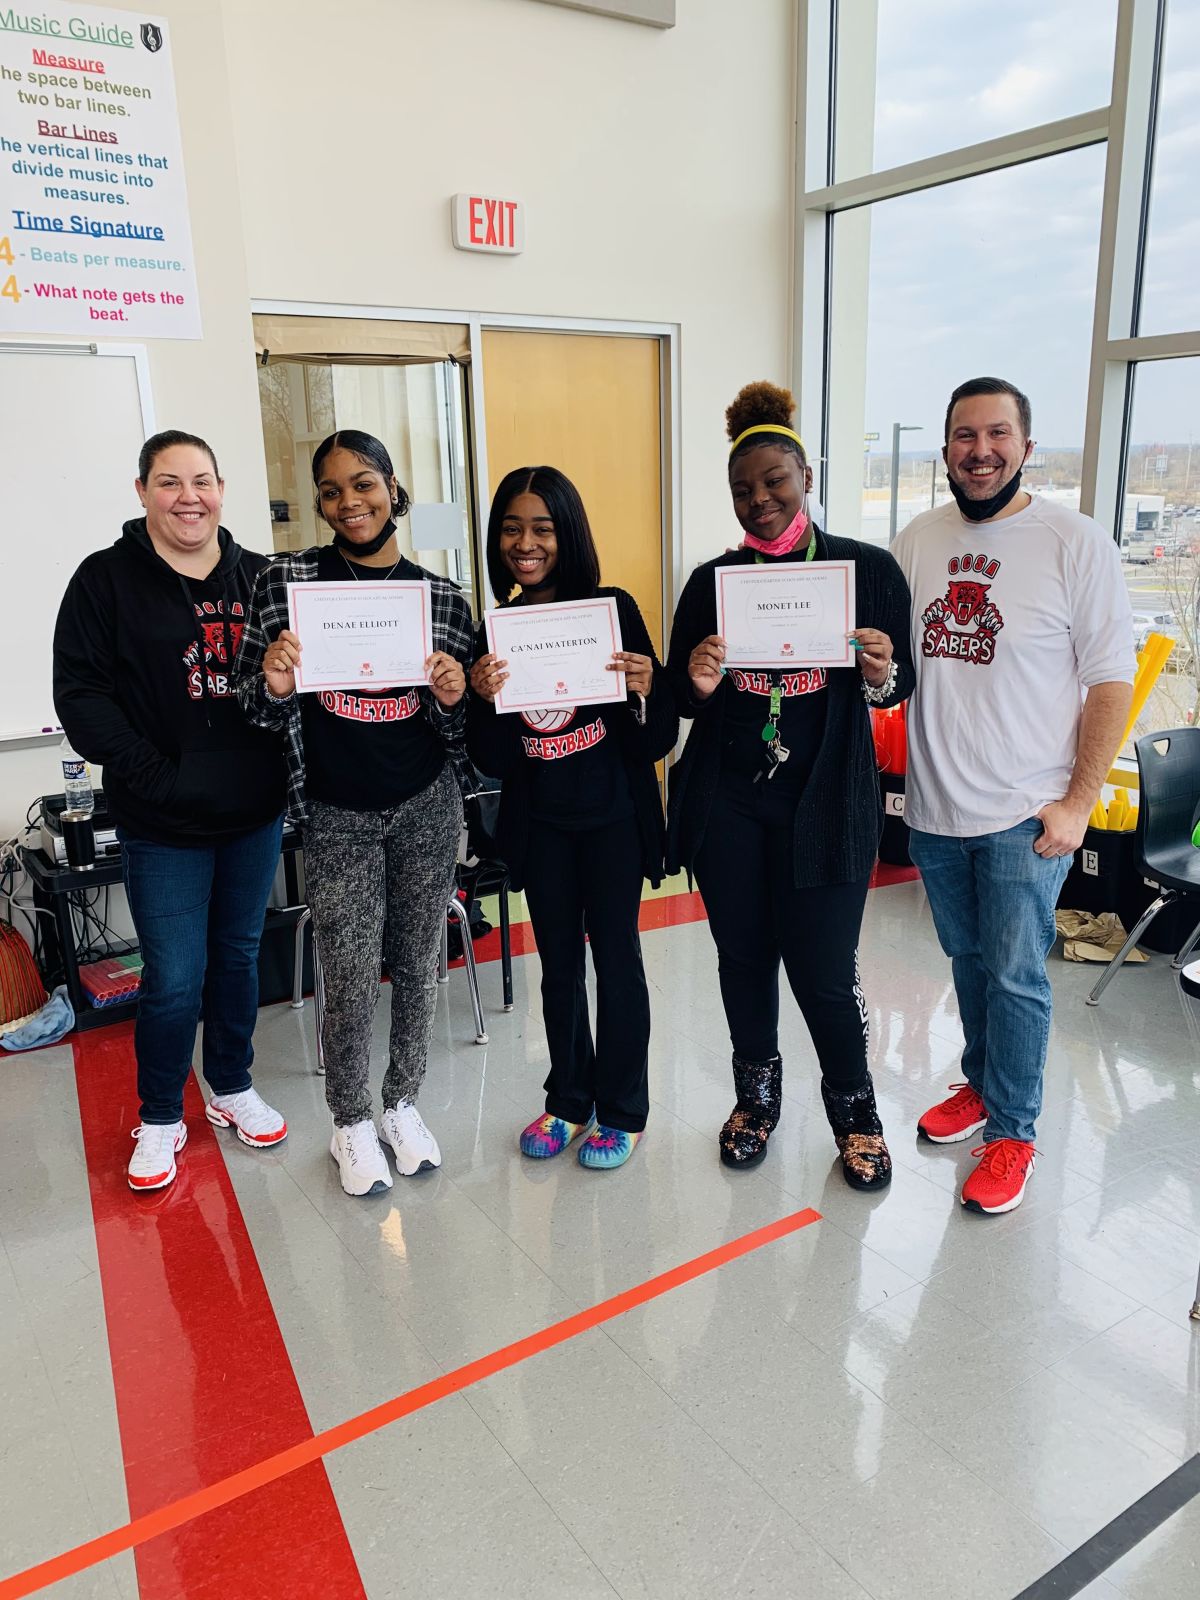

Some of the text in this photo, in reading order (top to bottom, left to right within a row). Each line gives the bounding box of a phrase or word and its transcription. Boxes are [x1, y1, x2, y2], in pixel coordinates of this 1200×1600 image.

[0, 9, 133, 46] Music Guide
[32, 48, 105, 73] Measure
[0, 65, 151, 99] he space between
[17, 89, 131, 117] two bar lines.
[38, 119, 118, 143] Bar Lines
[0, 136, 168, 169] he vertical lines that
[12, 160, 154, 188] divide music into
[44, 186, 130, 205] measures.
[12, 210, 164, 240] Time Signature
[469, 197, 518, 248] EXIT
[0, 236, 15, 265] 4
[30, 247, 78, 264] Beats
[83, 253, 109, 268] per
[115, 256, 186, 272] measure.
[1, 275, 22, 303] 4
[34, 283, 78, 299] What
[83, 286, 118, 301] note
[123, 290, 156, 305] gets
[161, 291, 185, 305] the
[89, 307, 129, 321] beat.
[757, 601, 811, 611] MONET LEE
[323, 619, 399, 630] DENAE ELLIOTT
[545, 636, 598, 649] WATERTON
[924, 627, 994, 661] SABERS
[892, 796, 903, 812] C
[1086, 852, 1096, 870] E
